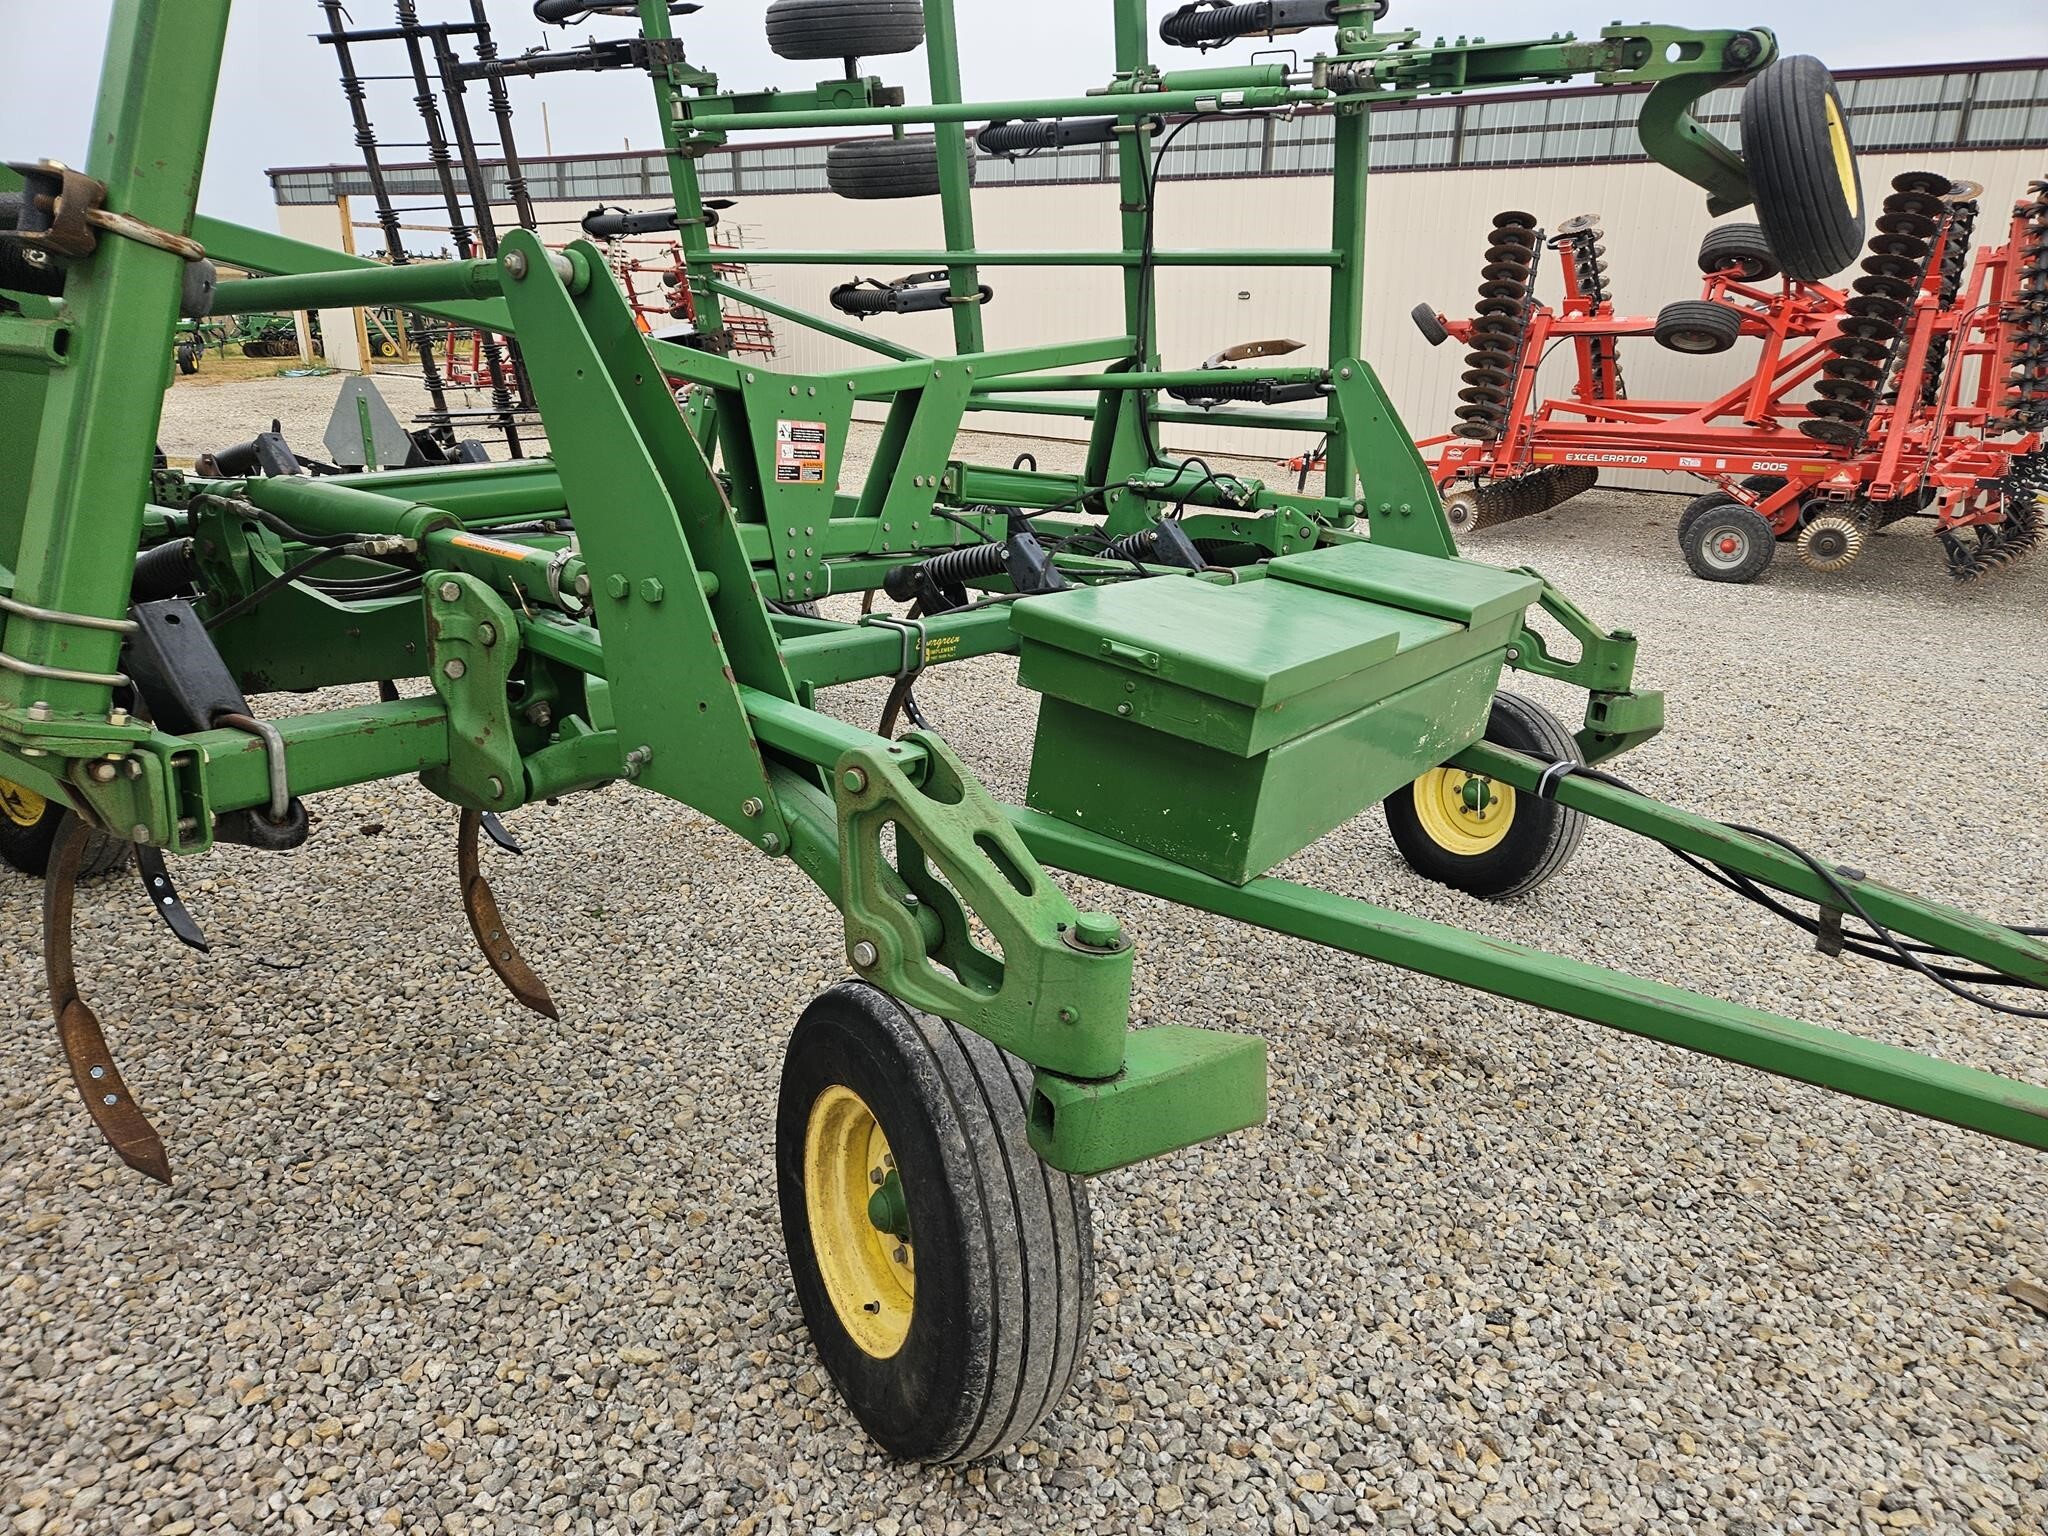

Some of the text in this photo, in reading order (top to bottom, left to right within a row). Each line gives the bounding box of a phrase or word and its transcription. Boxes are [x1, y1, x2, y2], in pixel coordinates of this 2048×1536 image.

[1565, 453, 1648, 464] EXCELERATOR
[1751, 461, 1789, 472] 8005
[915, 636, 960, 650] Eergreen
[930, 646, 956, 654] IMPLEMENT
